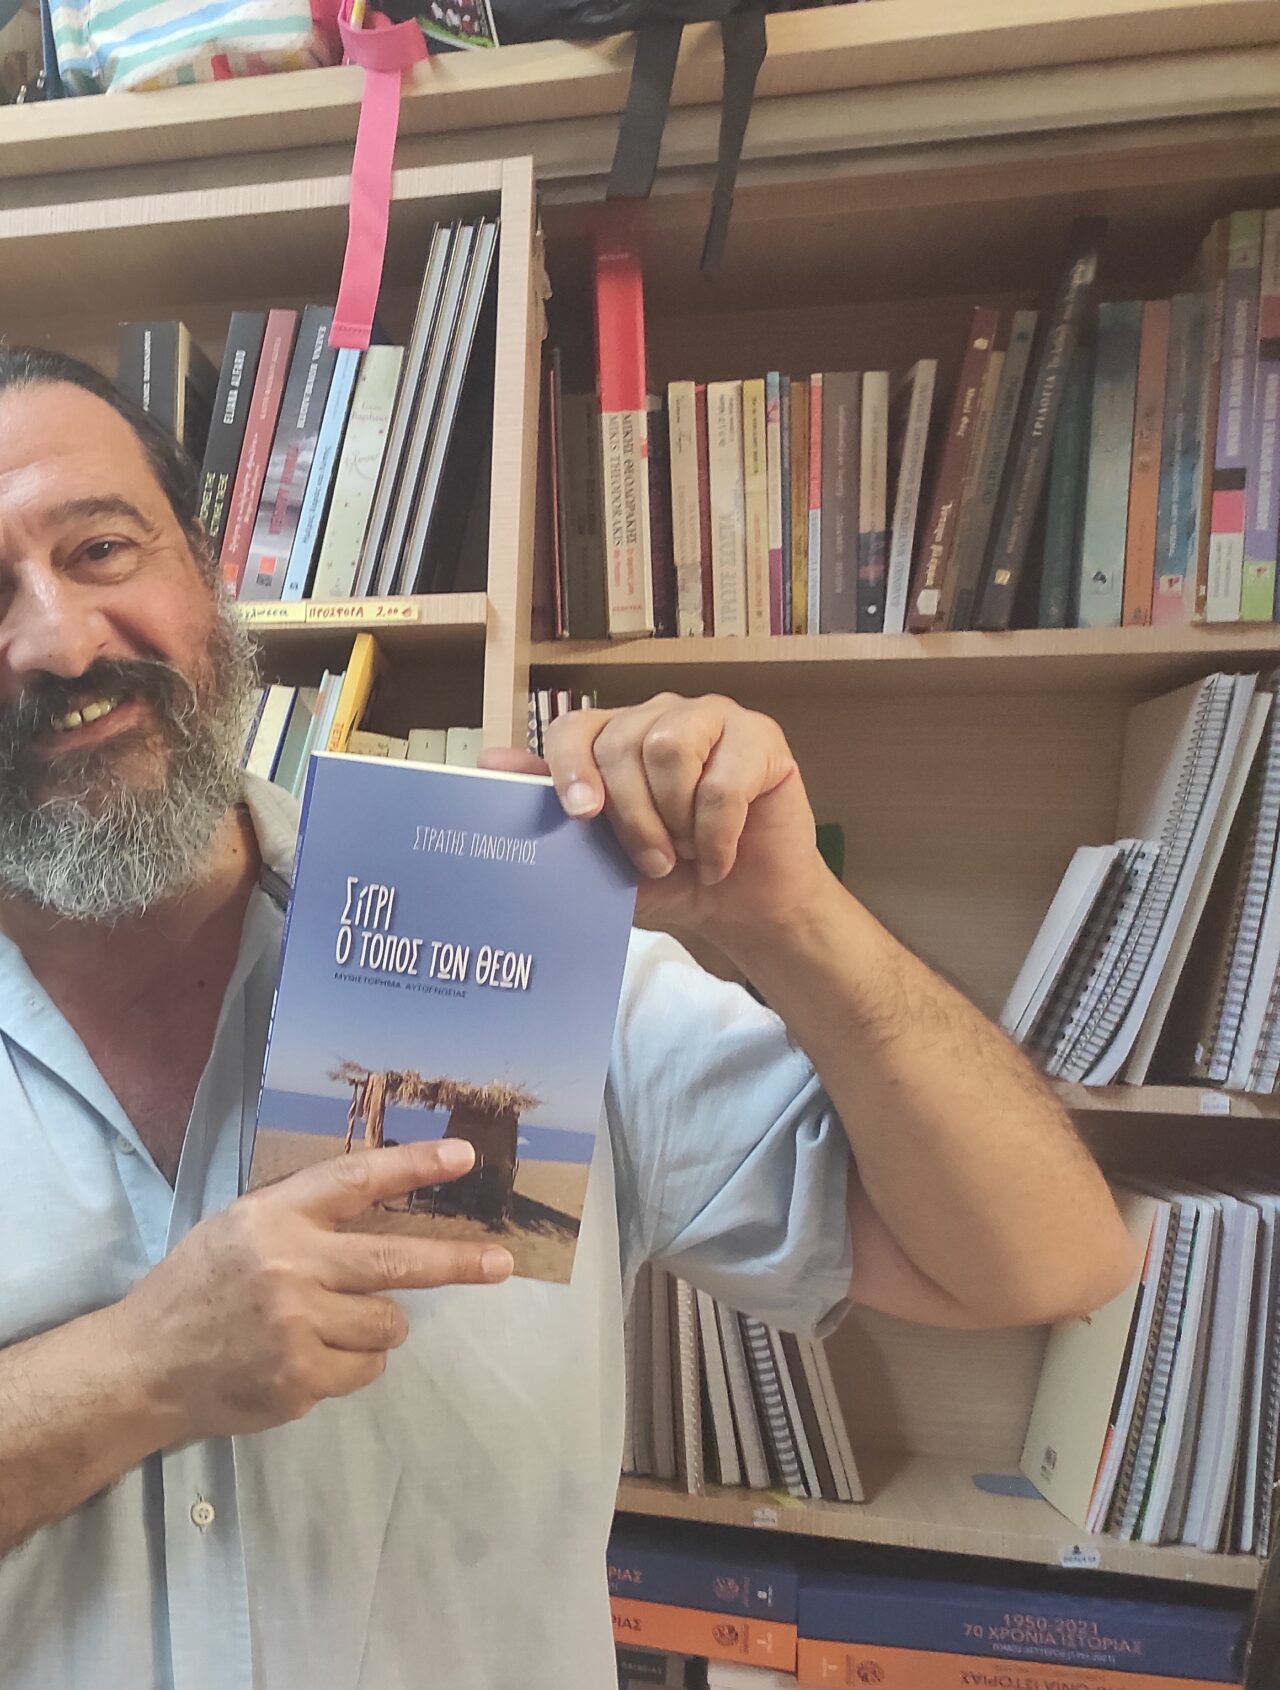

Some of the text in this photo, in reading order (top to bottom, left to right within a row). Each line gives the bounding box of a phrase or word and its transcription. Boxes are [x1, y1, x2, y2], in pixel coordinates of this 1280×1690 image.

[413, 825, 539, 865] ΣΤΡΑΤΗΣ ΠΑΝΟΥΡΙΟΣ
[335, 926, 533, 990] Ο ΤΟΠΟΣ ΤΩΝ ΘΕΩΝ
[333, 972, 401, 989] ΜΥΘΙΣΤΟΡΗΜΑ
[608, 1566, 642, 1584] ΡΙΑΣ
[611, 1615, 642, 1632] ΡΙΑΣ
[1002, 1613, 1099, 1636] 1950-2021
[964, 1623, 1147, 1655] 70 ΧΡΟΝΙΑ ΙΣΤΟΡΙΑΣ
